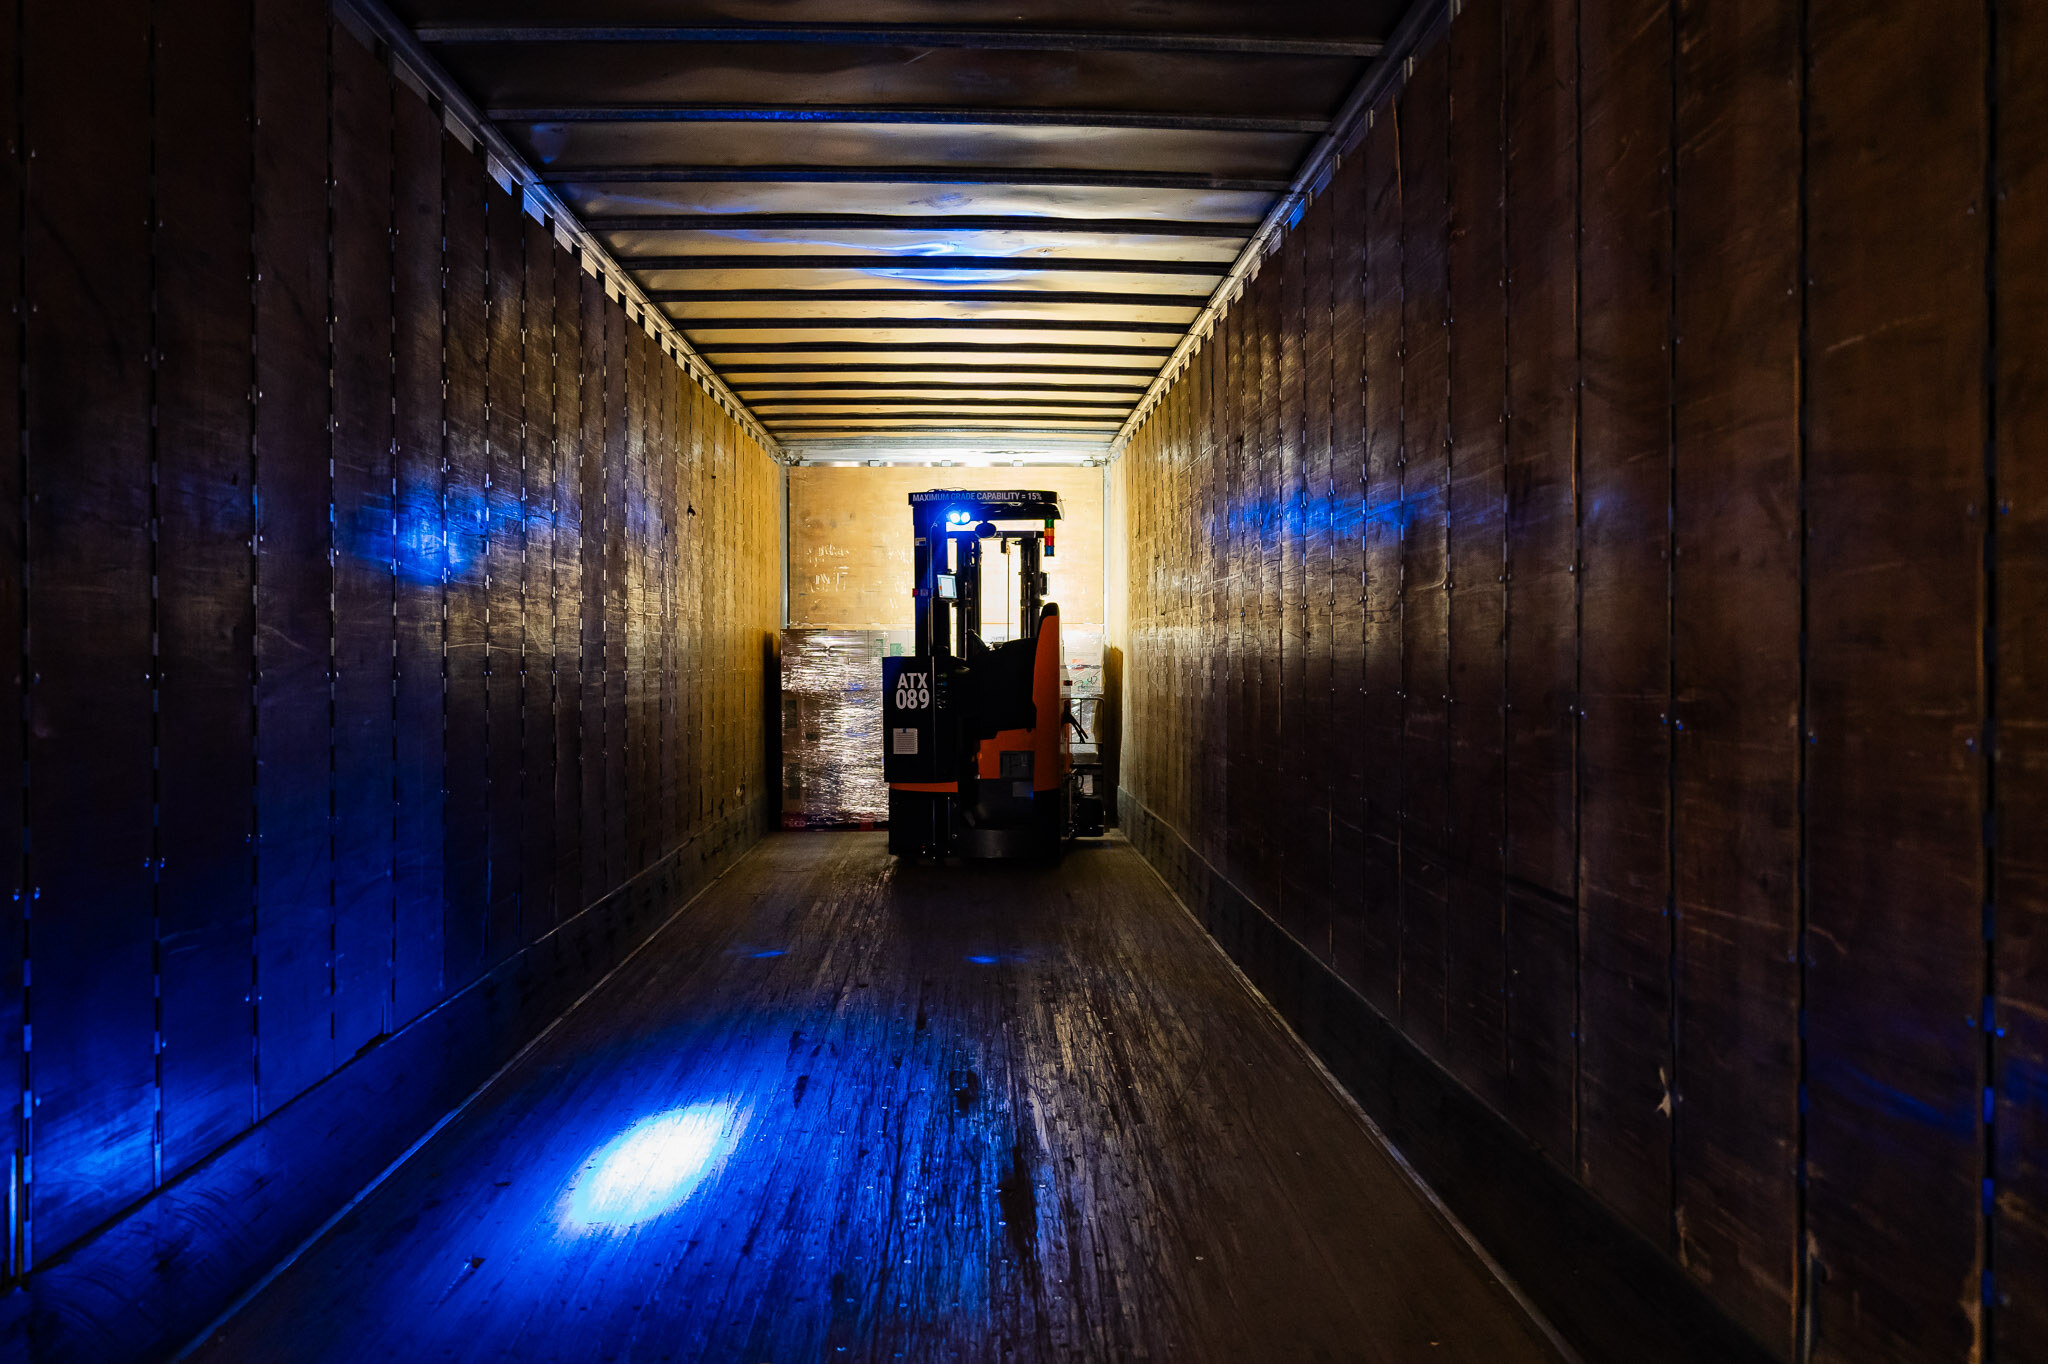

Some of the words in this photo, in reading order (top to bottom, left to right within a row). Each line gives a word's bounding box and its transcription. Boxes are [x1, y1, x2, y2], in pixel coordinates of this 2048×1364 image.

[912, 493, 950, 502] MAXIMUM
[950, 492, 976, 501] GRADE
[976, 492, 1020, 501] CAPABILITY
[1028, 492, 1043, 501] 15%
[897, 672, 928, 689] ATX
[895, 688, 930, 710] 089
